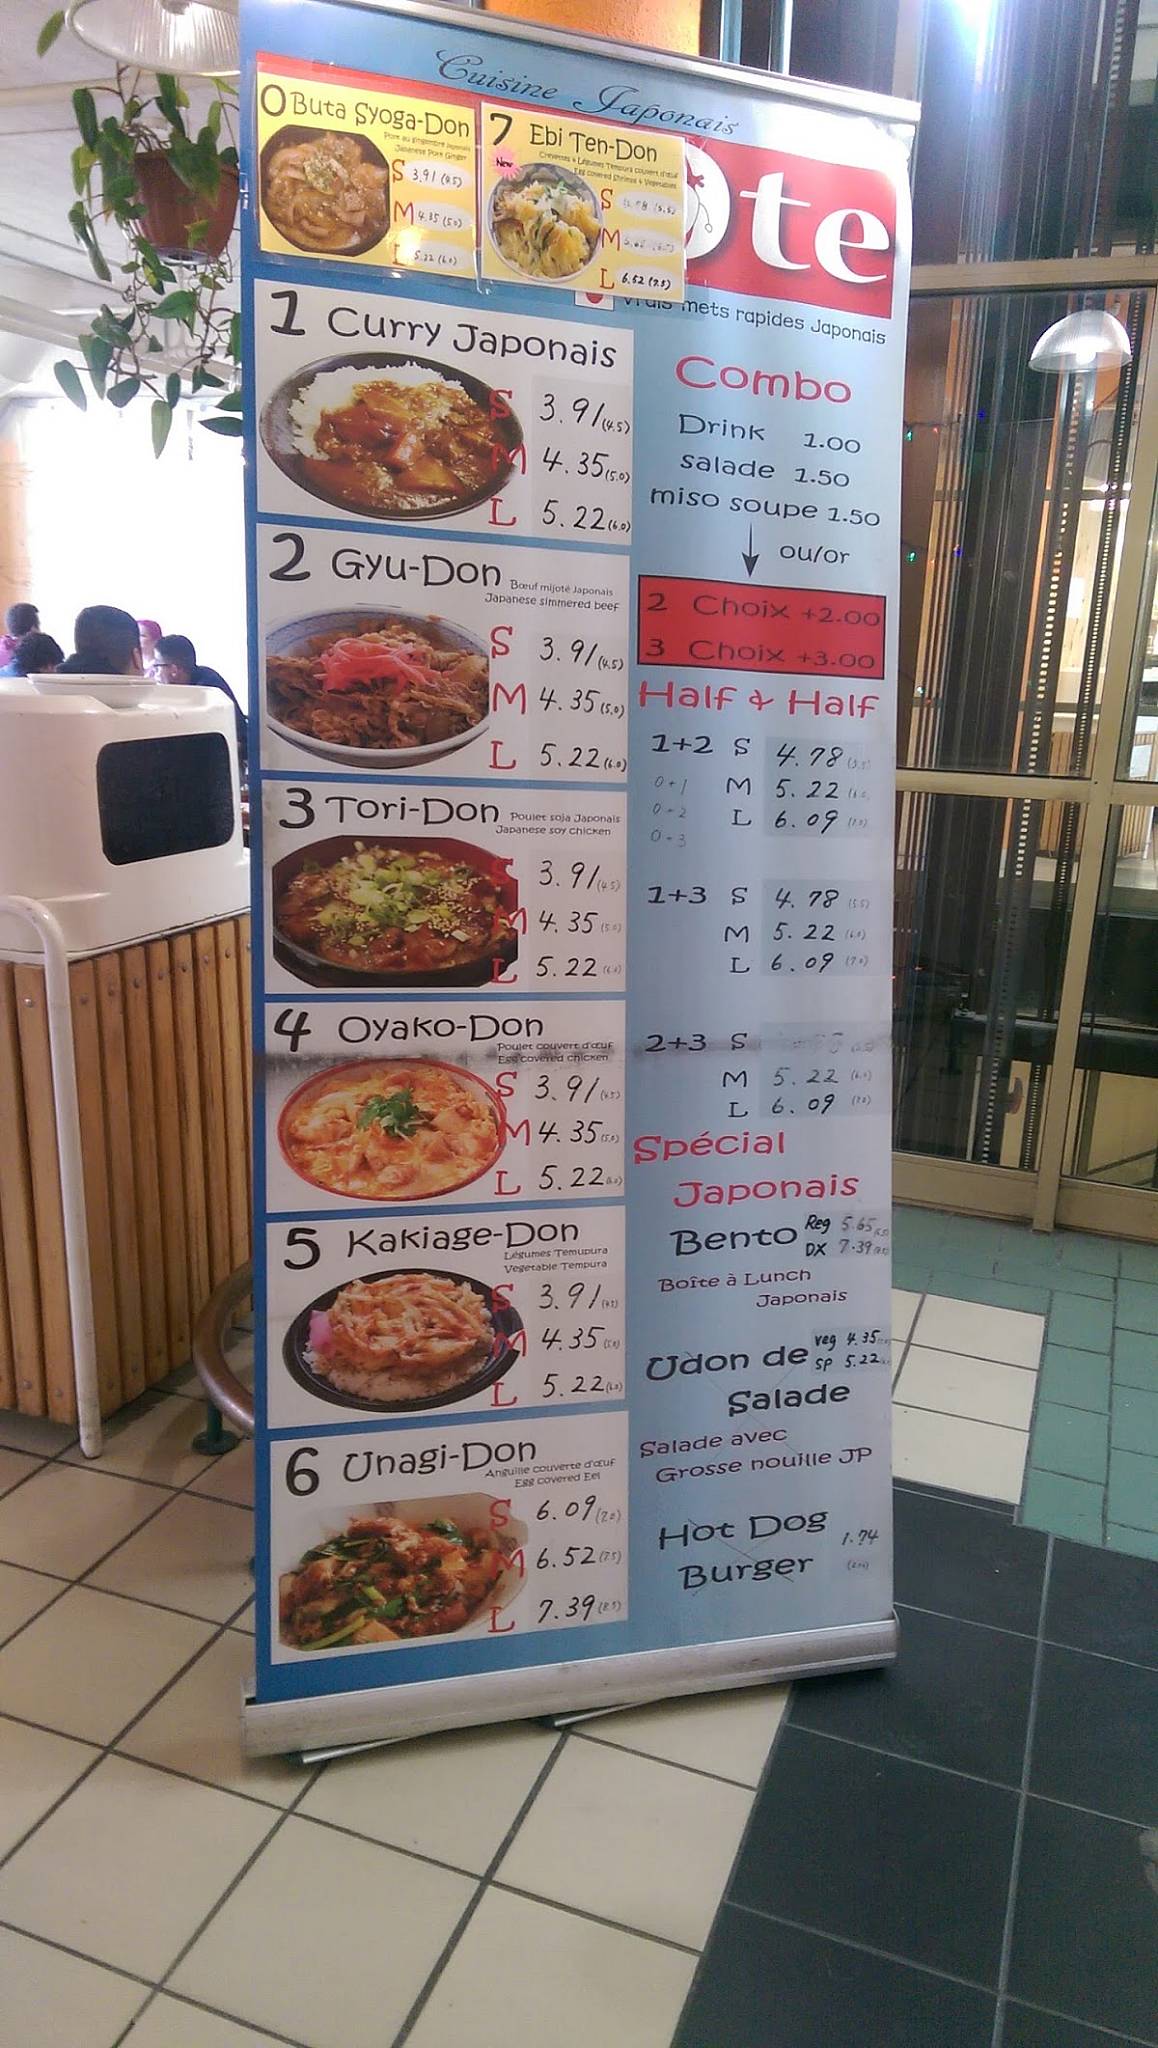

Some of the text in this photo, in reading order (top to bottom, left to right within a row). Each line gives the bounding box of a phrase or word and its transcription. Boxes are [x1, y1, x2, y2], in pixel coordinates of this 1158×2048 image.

[436, 50, 738, 134] Cuisine Japonais
[291, 91, 346, 119] Buta
[355, 102, 470, 138] Syoga-Don
[490, 112, 512, 146] 7
[530, 123, 562, 146] Ebi
[569, 132, 657, 163] Ten-Don
[392, 159, 435, 183] S 3.91
[496, 158, 513, 168] New
[394, 201, 414, 224] M
[601, 189, 613, 210] S
[602, 228, 620, 251] M
[600, 268, 644, 289] L 6.52
[270, 290, 617, 368] 1 Curry Japonais
[682, 301, 886, 345] mets rapides Japonais
[676, 355, 852, 403] Combo
[489, 389, 512, 419] S
[540, 394, 605, 427] 3.91
[679, 414, 861, 454] Drink 1.00
[491, 443, 526, 475] M
[542, 447, 609, 477] 4.35
[680, 454, 850, 487] salade 1.50
[488, 498, 516, 526] L
[542, 499, 605, 530] 5.22
[650, 487, 881, 526] miso soupe 1.50
[269, 533, 501, 587] 2 Gyu-Don
[780, 545, 850, 564] ou/or
[485, 593, 620, 611] Japanese simmered beef
[573, 587, 613, 596] Japonais
[647, 593, 881, 627] 2 Choix +2.00
[490, 626, 513, 658] S
[540, 637, 598, 666] 3.91
[645, 638, 875, 669] 3 Choix +3.00
[493, 682, 526, 715] M
[539, 687, 600, 713] 4.35
[638, 680, 879, 719] Half Half
[489, 741, 600, 770] L 5.22
[652, 734, 713, 754] 1+2
[734, 738, 751, 756] S
[777, 744, 843, 767] 4.78
[726, 777, 751, 796] M
[776, 779, 839, 799] 5.22
[278, 787, 500, 830] 3 Tori-Don
[510, 812, 620, 824] Poulet soja Japonais
[731, 809, 752, 825] L
[774, 810, 839, 834] 6.09
[496, 825, 566, 836] Japanese soy
[539, 860, 600, 890] 3.91
[648, 886, 706, 904] 1+3
[731, 887, 748, 905] S
[776, 888, 839, 909] 4.78
[539, 910, 598, 934] 4.35
[724, 926, 749, 943] M
[773, 922, 836, 941] 5.22
[491, 958, 518, 984] L
[536, 956, 598, 977] 5.22
[729, 957, 750, 973] L
[771, 952, 834, 973] 6.09
[273, 1008, 544, 1053] 4 Oyako-Don
[645, 1033, 748, 1052] 2+3 S
[497, 1042, 580, 1051] Poulet couvert
[498, 1055, 518, 1065] Egg
[520, 1054, 564, 1063] covered
[495, 1072, 517, 1097] S
[535, 1075, 600, 1103] 3.91
[722, 1070, 747, 1088] M
[773, 1067, 839, 1087] 5.22
[728, 1102, 748, 1118] L
[772, 1093, 835, 1115] 6.09
[500, 1119, 603, 1146] M 4.35
[633, 1130, 785, 1164] Spécial
[494, 1165, 604, 1195] L 5.22
[672, 1174, 860, 1208] Japonais
[805, 1215, 831, 1235] Reg
[283, 1221, 579, 1271] 5 Kakiage-Don
[669, 1227, 797, 1256] Bento
[805, 1242, 827, 1257] DX
[504, 1260, 607, 1273] Vegetable Tempura
[657, 1269, 811, 1292] Boîte à Lunch
[492, 1282, 601, 1313] S 3.91
[756, 1290, 847, 1308] Japonais
[492, 1326, 605, 1358] M 4.35
[846, 1330, 880, 1347] 4.35
[645, 1346, 808, 1381] Udon de
[844, 1353, 881, 1368] 5.22
[490, 1382, 517, 1407] L
[543, 1374, 604, 1398] 5.22
[728, 1384, 851, 1417] Salade
[640, 1429, 788, 1458] Salade avec
[285, 1440, 536, 1497] 6 Unagi-Don
[485, 1462, 581, 1478] Anguille couverte
[656, 1447, 873, 1483] Grosse nouille JP
[515, 1473, 601, 1488] Egg covered Eel
[489, 1499, 511, 1531] S
[537, 1495, 596, 1521] 6.09
[659, 1511, 828, 1550] Hot Dog
[491, 1547, 596, 1578] M 6.52
[678, 1556, 814, 1590] Burger
[488, 1606, 516, 1633] L
[538, 1595, 595, 1623] 7.39
